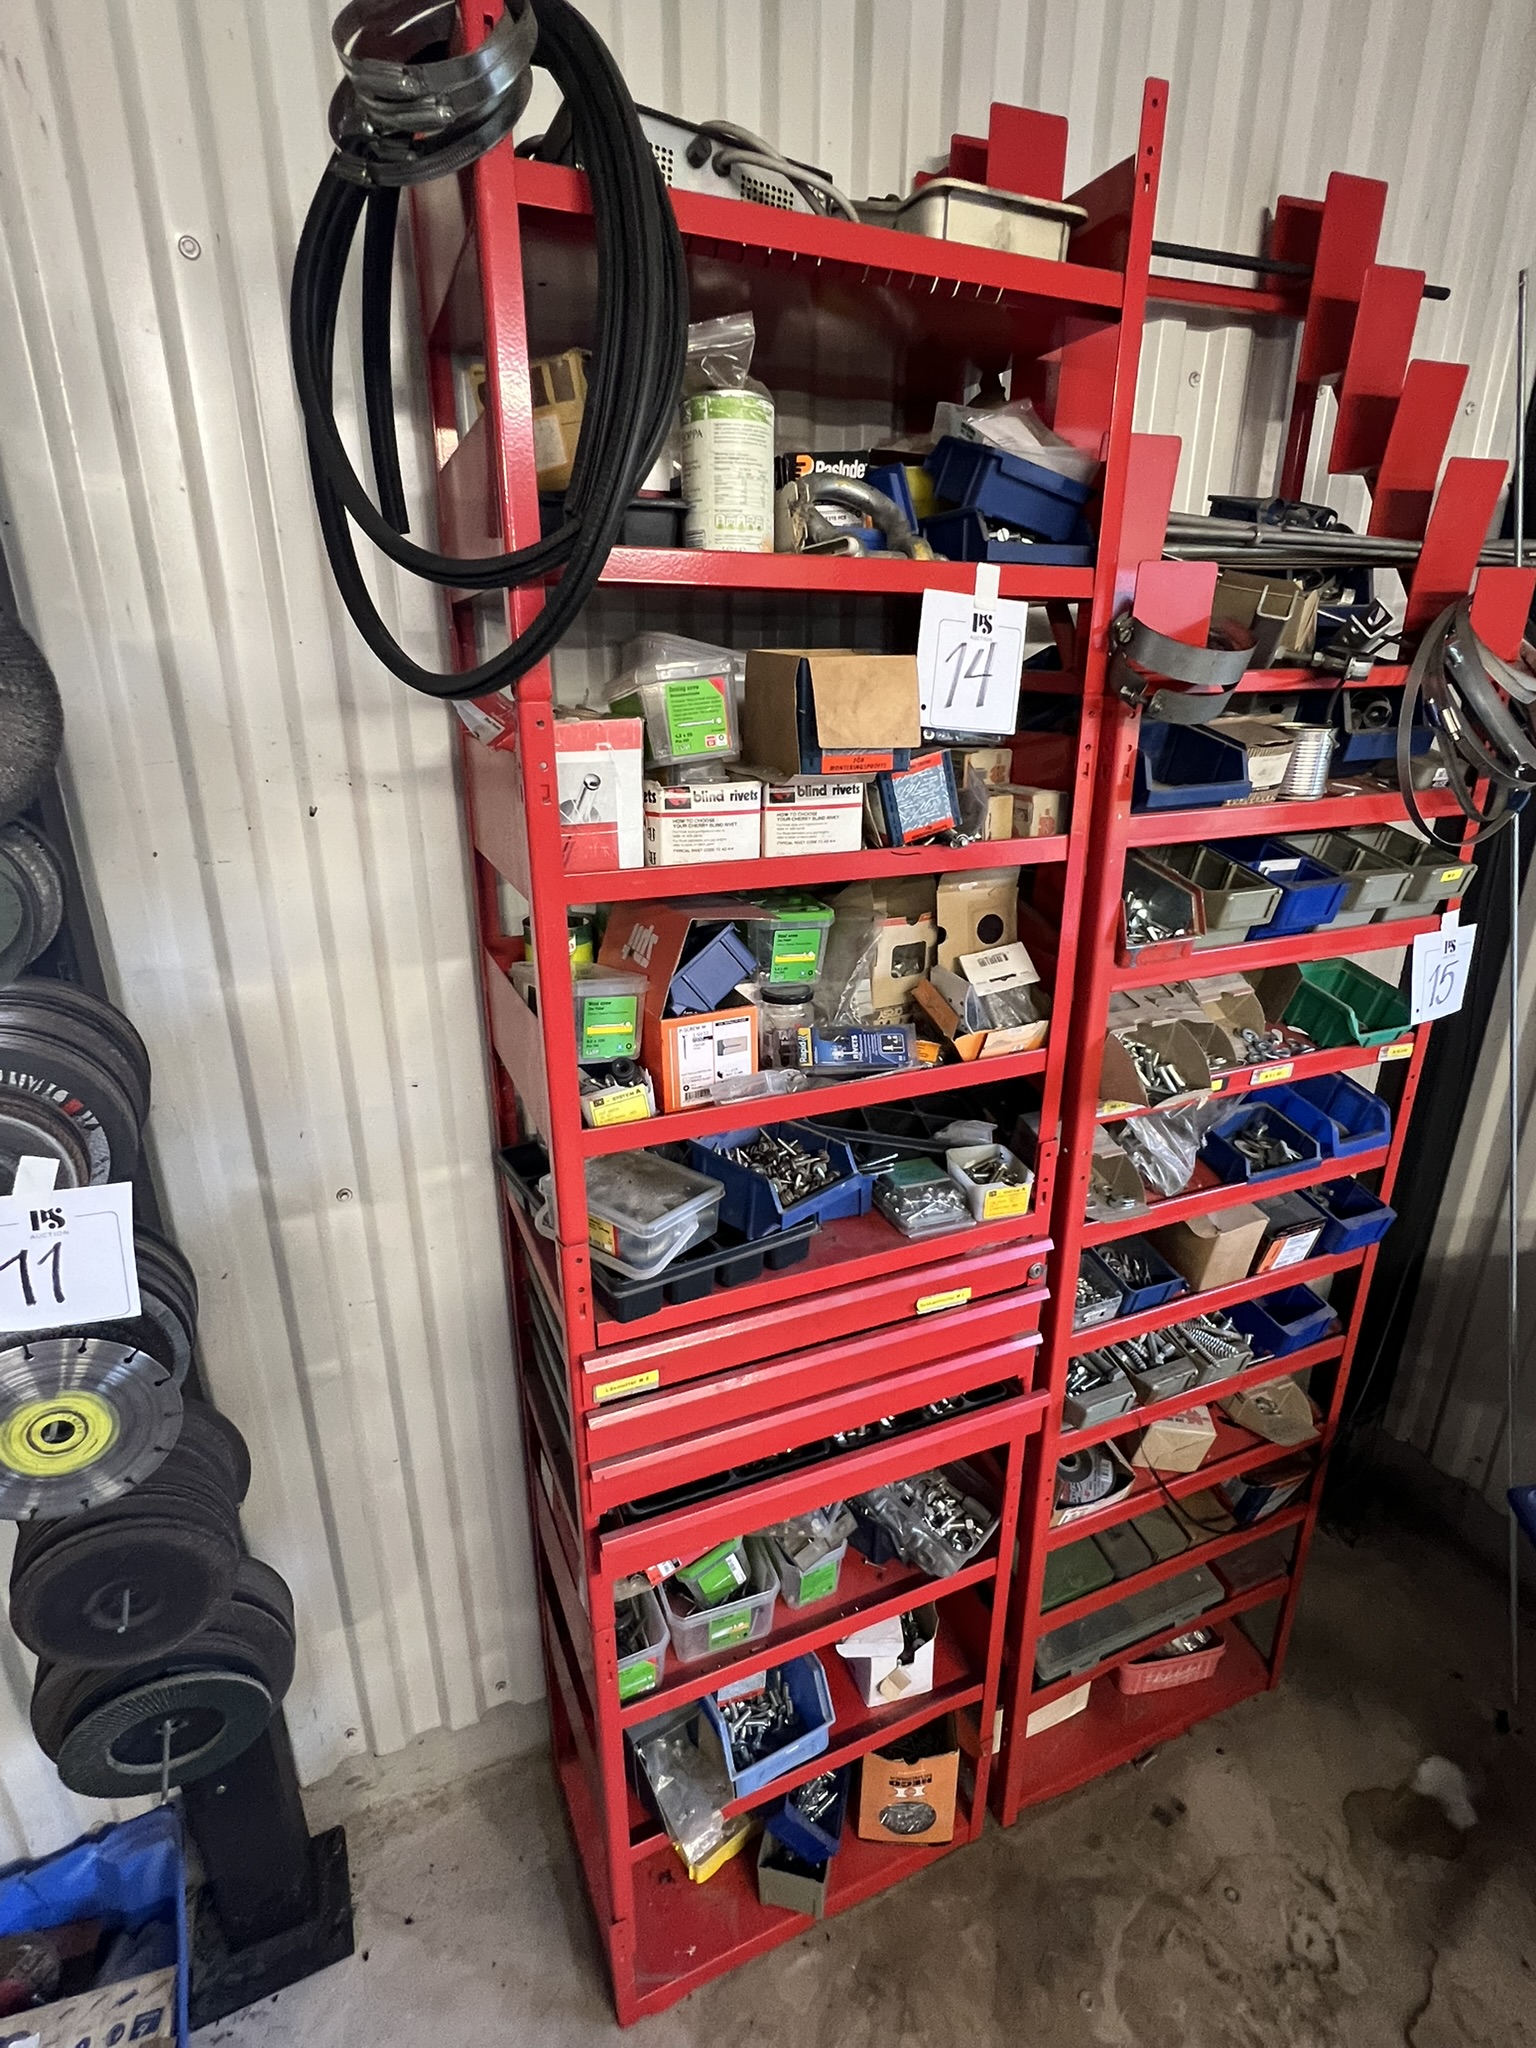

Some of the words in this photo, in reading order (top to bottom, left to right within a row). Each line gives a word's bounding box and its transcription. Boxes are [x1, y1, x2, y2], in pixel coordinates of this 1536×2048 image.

[815, 459, 866, 479] Paslode
[944, 641, 998, 709] 14
[693, 789, 725, 803] blind
[730, 789, 758, 802] rivets
[797, 784, 827, 798] blind
[832, 784, 860, 796] rivets
[1428, 960, 1460, 1008] 15
[799, 1040, 808, 1063] Rapid
[30, 1229, 70, 1240] AUCTION
[0, 1241, 66, 1306] 11
